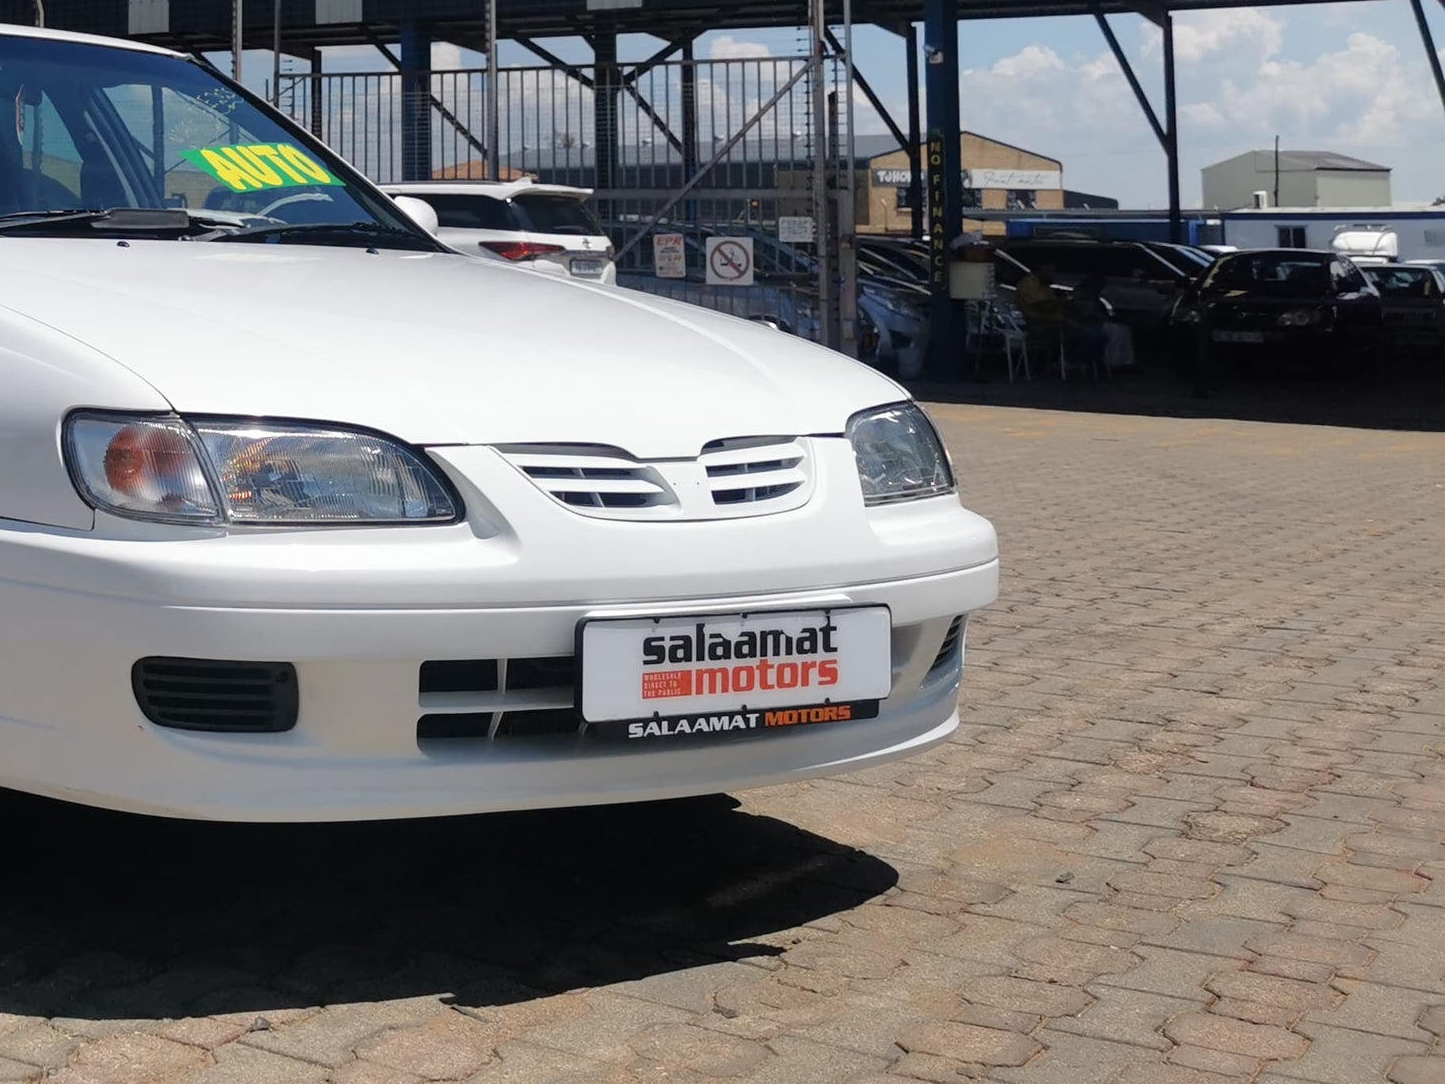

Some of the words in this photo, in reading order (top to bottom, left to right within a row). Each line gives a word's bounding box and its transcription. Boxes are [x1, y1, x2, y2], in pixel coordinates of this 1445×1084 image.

[200, 143, 332, 191] AUTO
[643, 617, 838, 665] salaamat
[695, 659, 839, 695] motors
[628, 713, 760, 739] SALAAMAT
[764, 705, 852, 727] MOTORS
